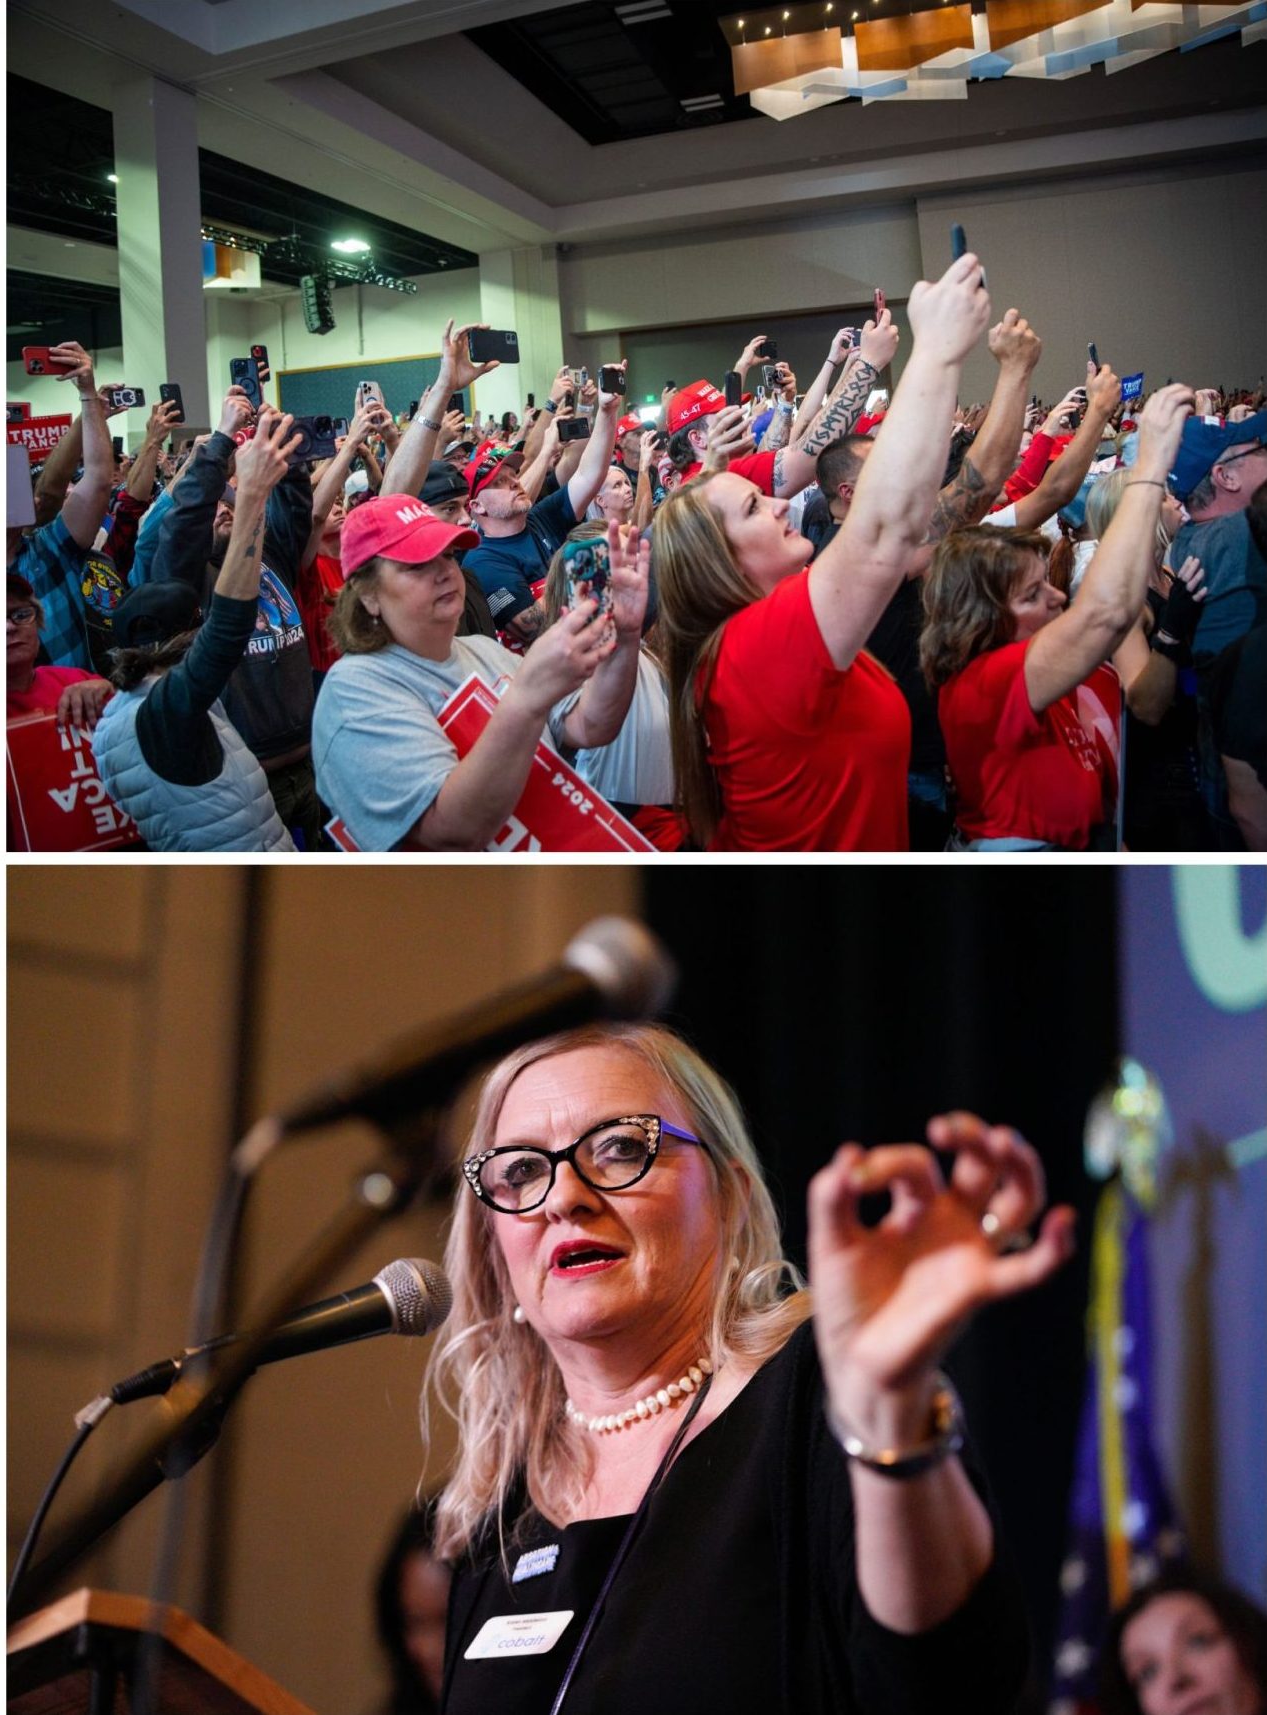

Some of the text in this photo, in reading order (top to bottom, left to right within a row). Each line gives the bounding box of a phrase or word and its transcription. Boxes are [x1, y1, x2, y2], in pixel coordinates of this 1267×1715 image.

[9, 425, 70, 442] TRUMP
[552, 772, 594, 815] 2024
[498, 1634, 547, 1649] cobalt
